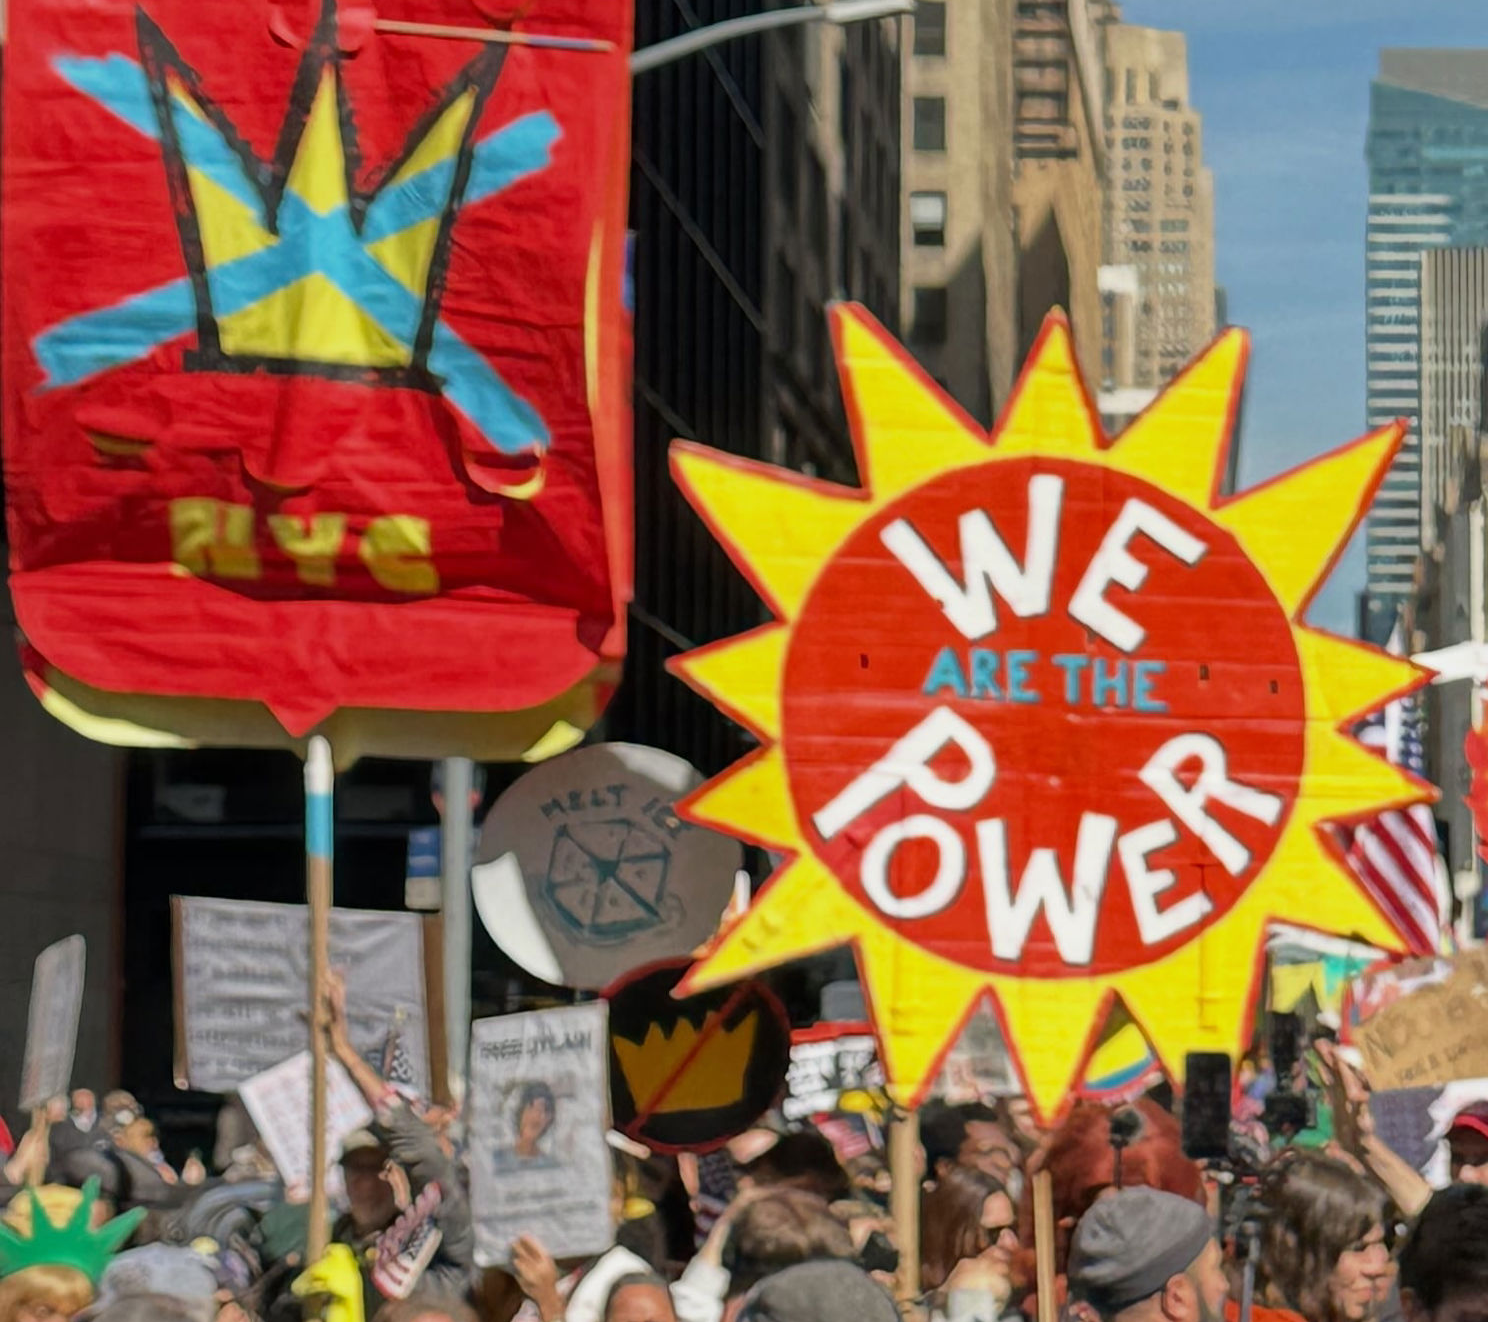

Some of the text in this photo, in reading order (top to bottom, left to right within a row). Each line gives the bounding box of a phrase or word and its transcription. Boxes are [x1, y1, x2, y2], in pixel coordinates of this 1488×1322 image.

[879, 474, 1208, 654] WE
[921, 646, 1170, 713] ARE THE
[812, 705, 1285, 966] POWER
